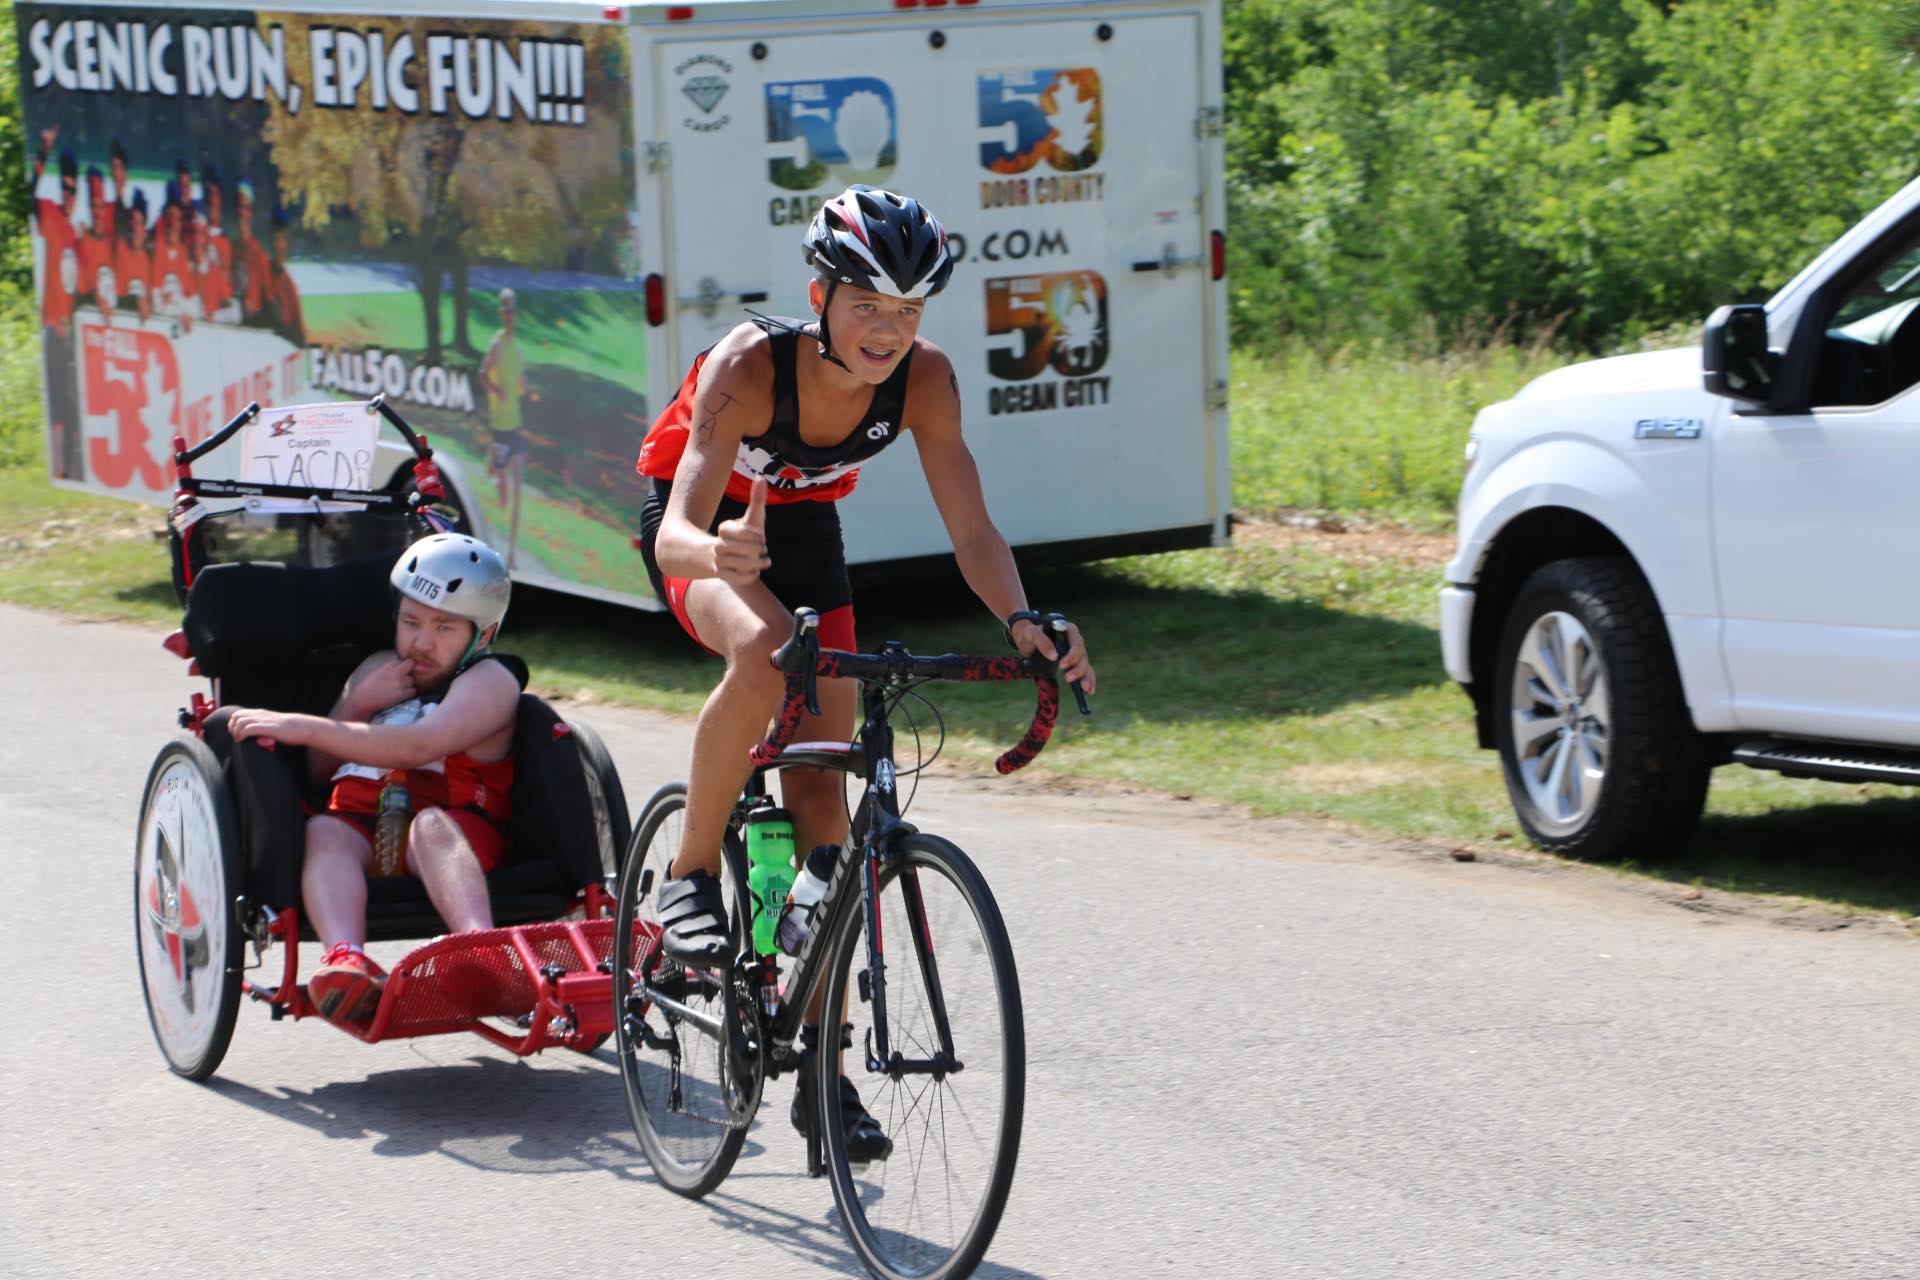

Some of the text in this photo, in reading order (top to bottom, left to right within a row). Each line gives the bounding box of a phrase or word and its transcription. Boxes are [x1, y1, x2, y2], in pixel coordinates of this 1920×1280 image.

[28, 18, 586, 124] SCENIC RUN, EPIC FUN!!!
[311, 348, 476, 412] FALL50.COM
[988, 375, 1112, 416] OCEAN CITY
[287, 438, 331, 450] Captain
[410, 575, 441, 600] MTT5
